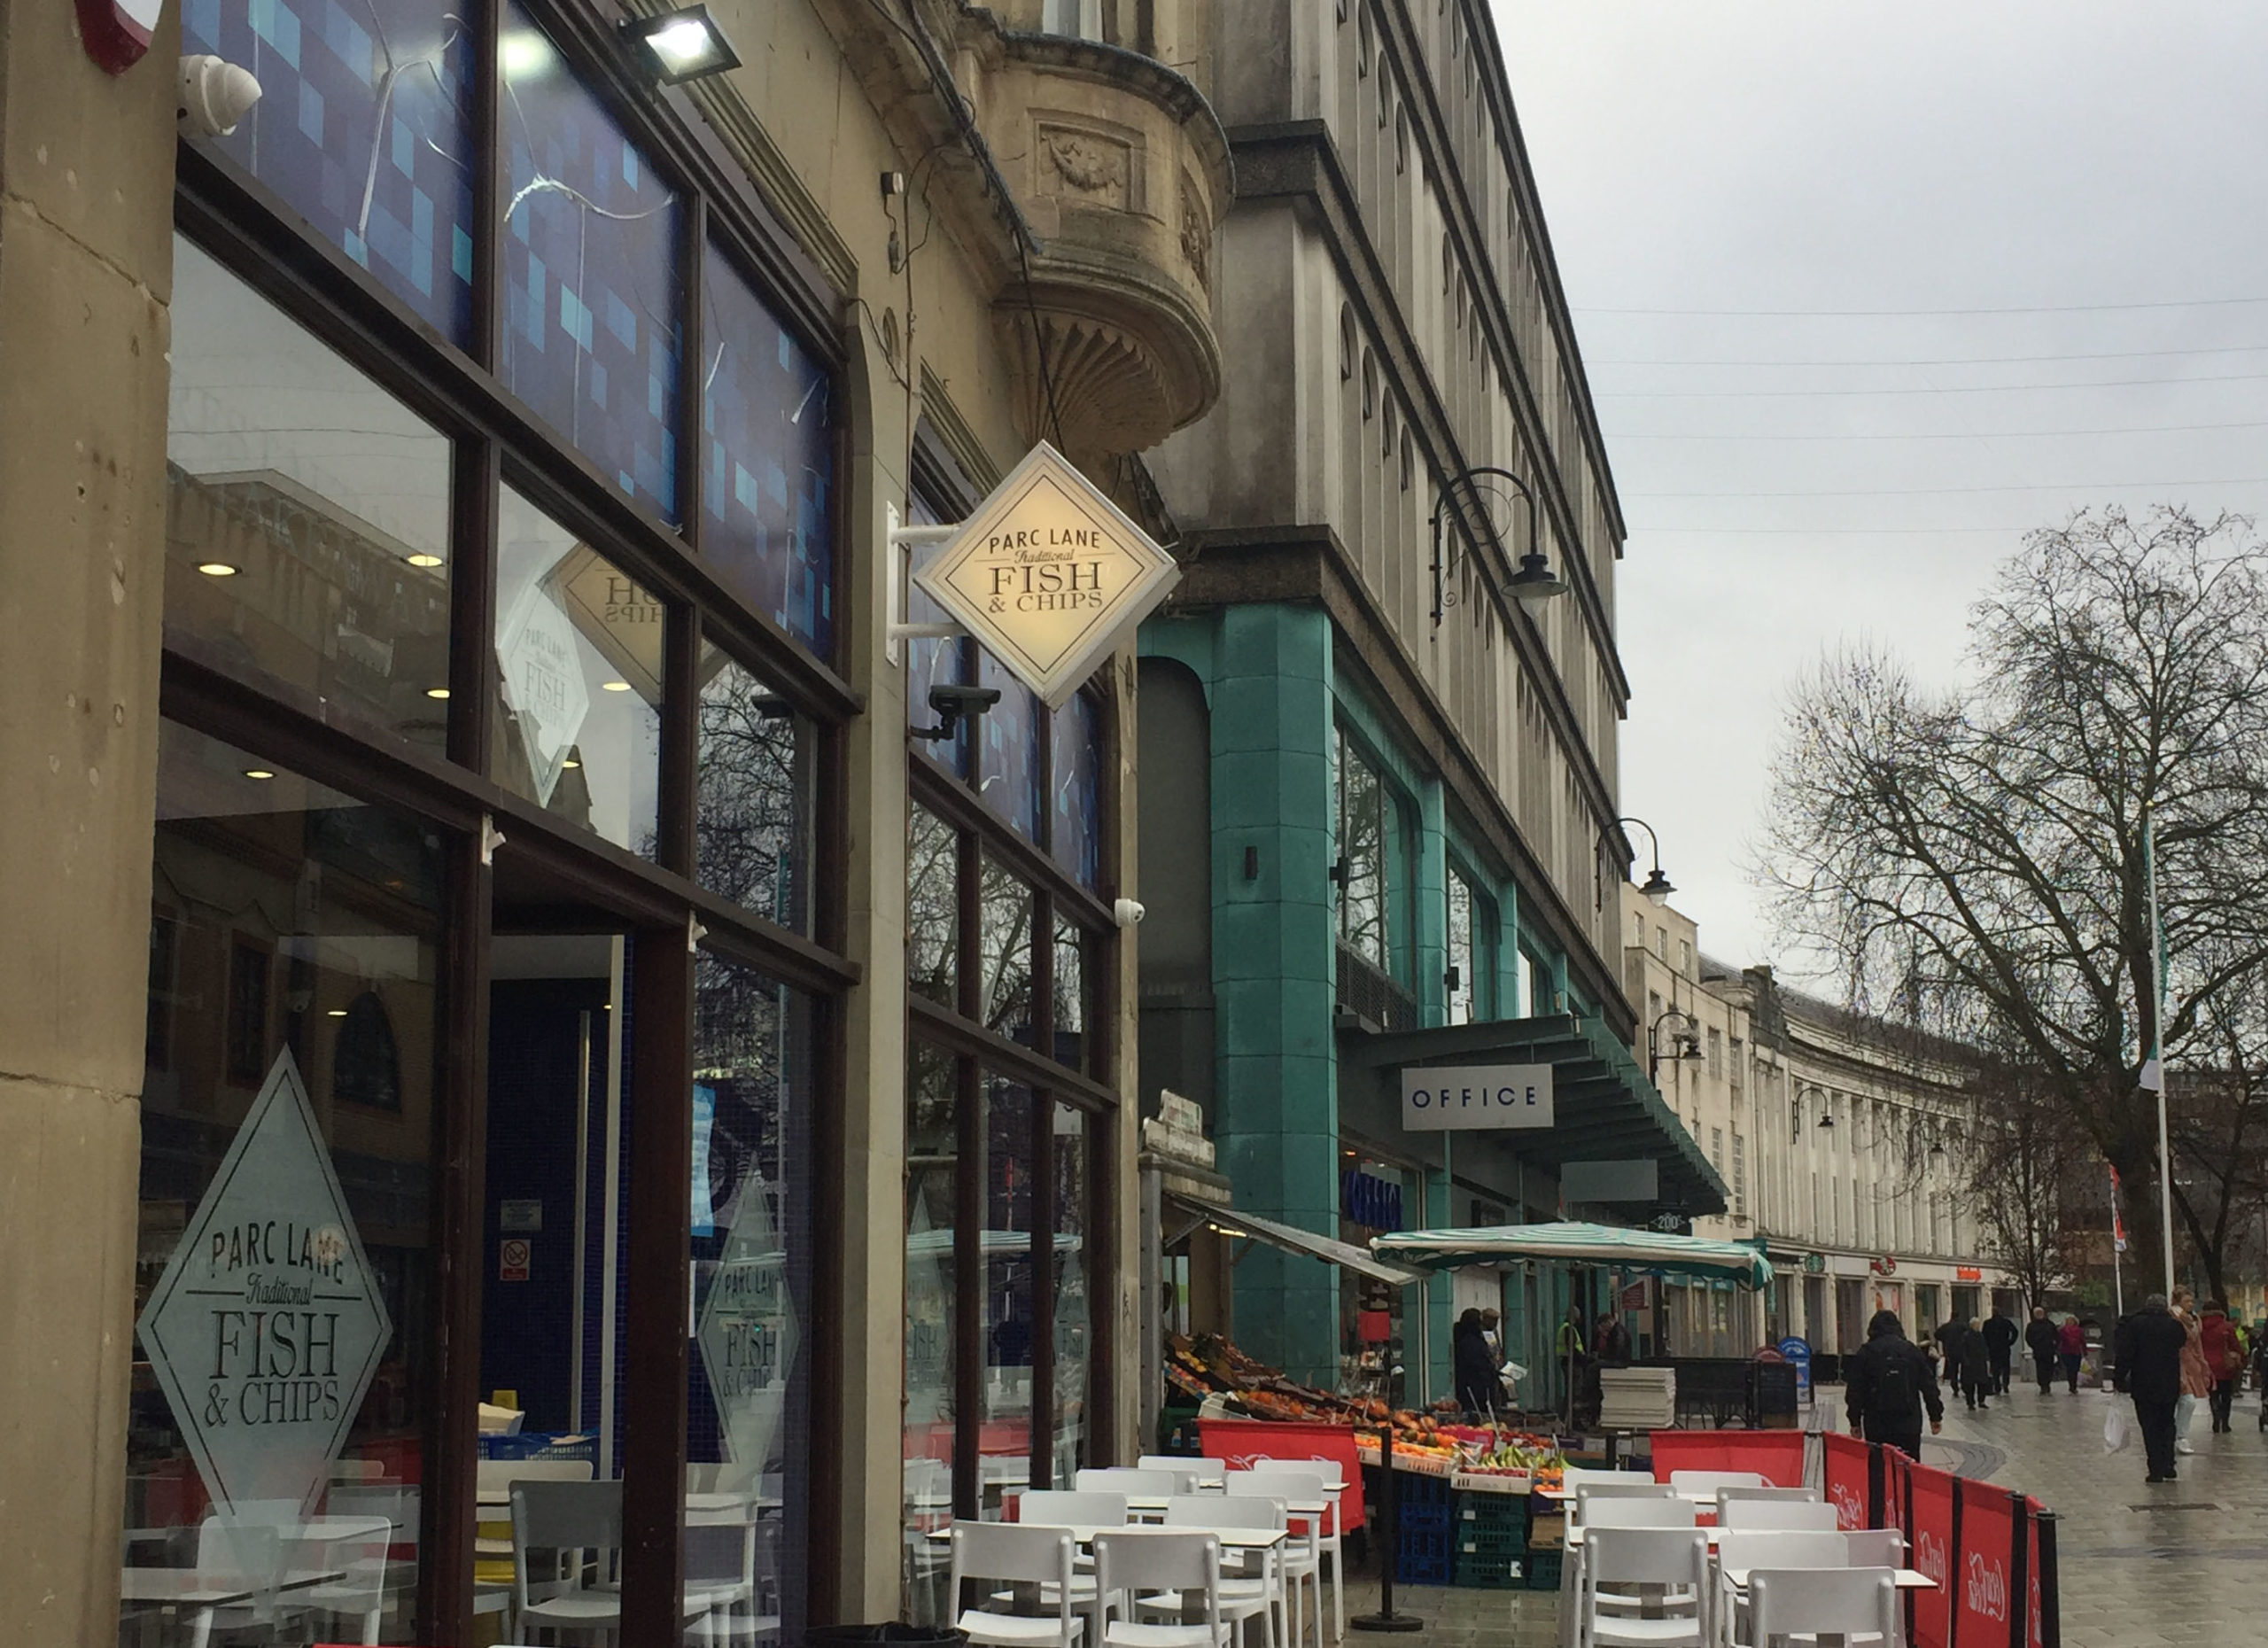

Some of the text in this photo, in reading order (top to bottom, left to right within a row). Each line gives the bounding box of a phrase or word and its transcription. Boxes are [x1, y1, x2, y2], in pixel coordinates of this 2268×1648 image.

[990, 529, 1101, 554] PARC LANE
[1014, 548, 1075, 564] Traditional
[988, 562, 1103, 596] FISH
[988, 592, 1103, 613] & CHIPS
[524, 661, 565, 711] FISH
[1411, 1086, 1535, 1108] OFFICE
[211, 1221, 276, 1278] PARC
[245, 1272, 313, 1307] Traditional
[755, 1266, 779, 1300] LAN
[209, 1310, 340, 1380] FISH
[725, 1322, 776, 1367] FISH
[205, 1380, 340, 1429] & CHIPS
